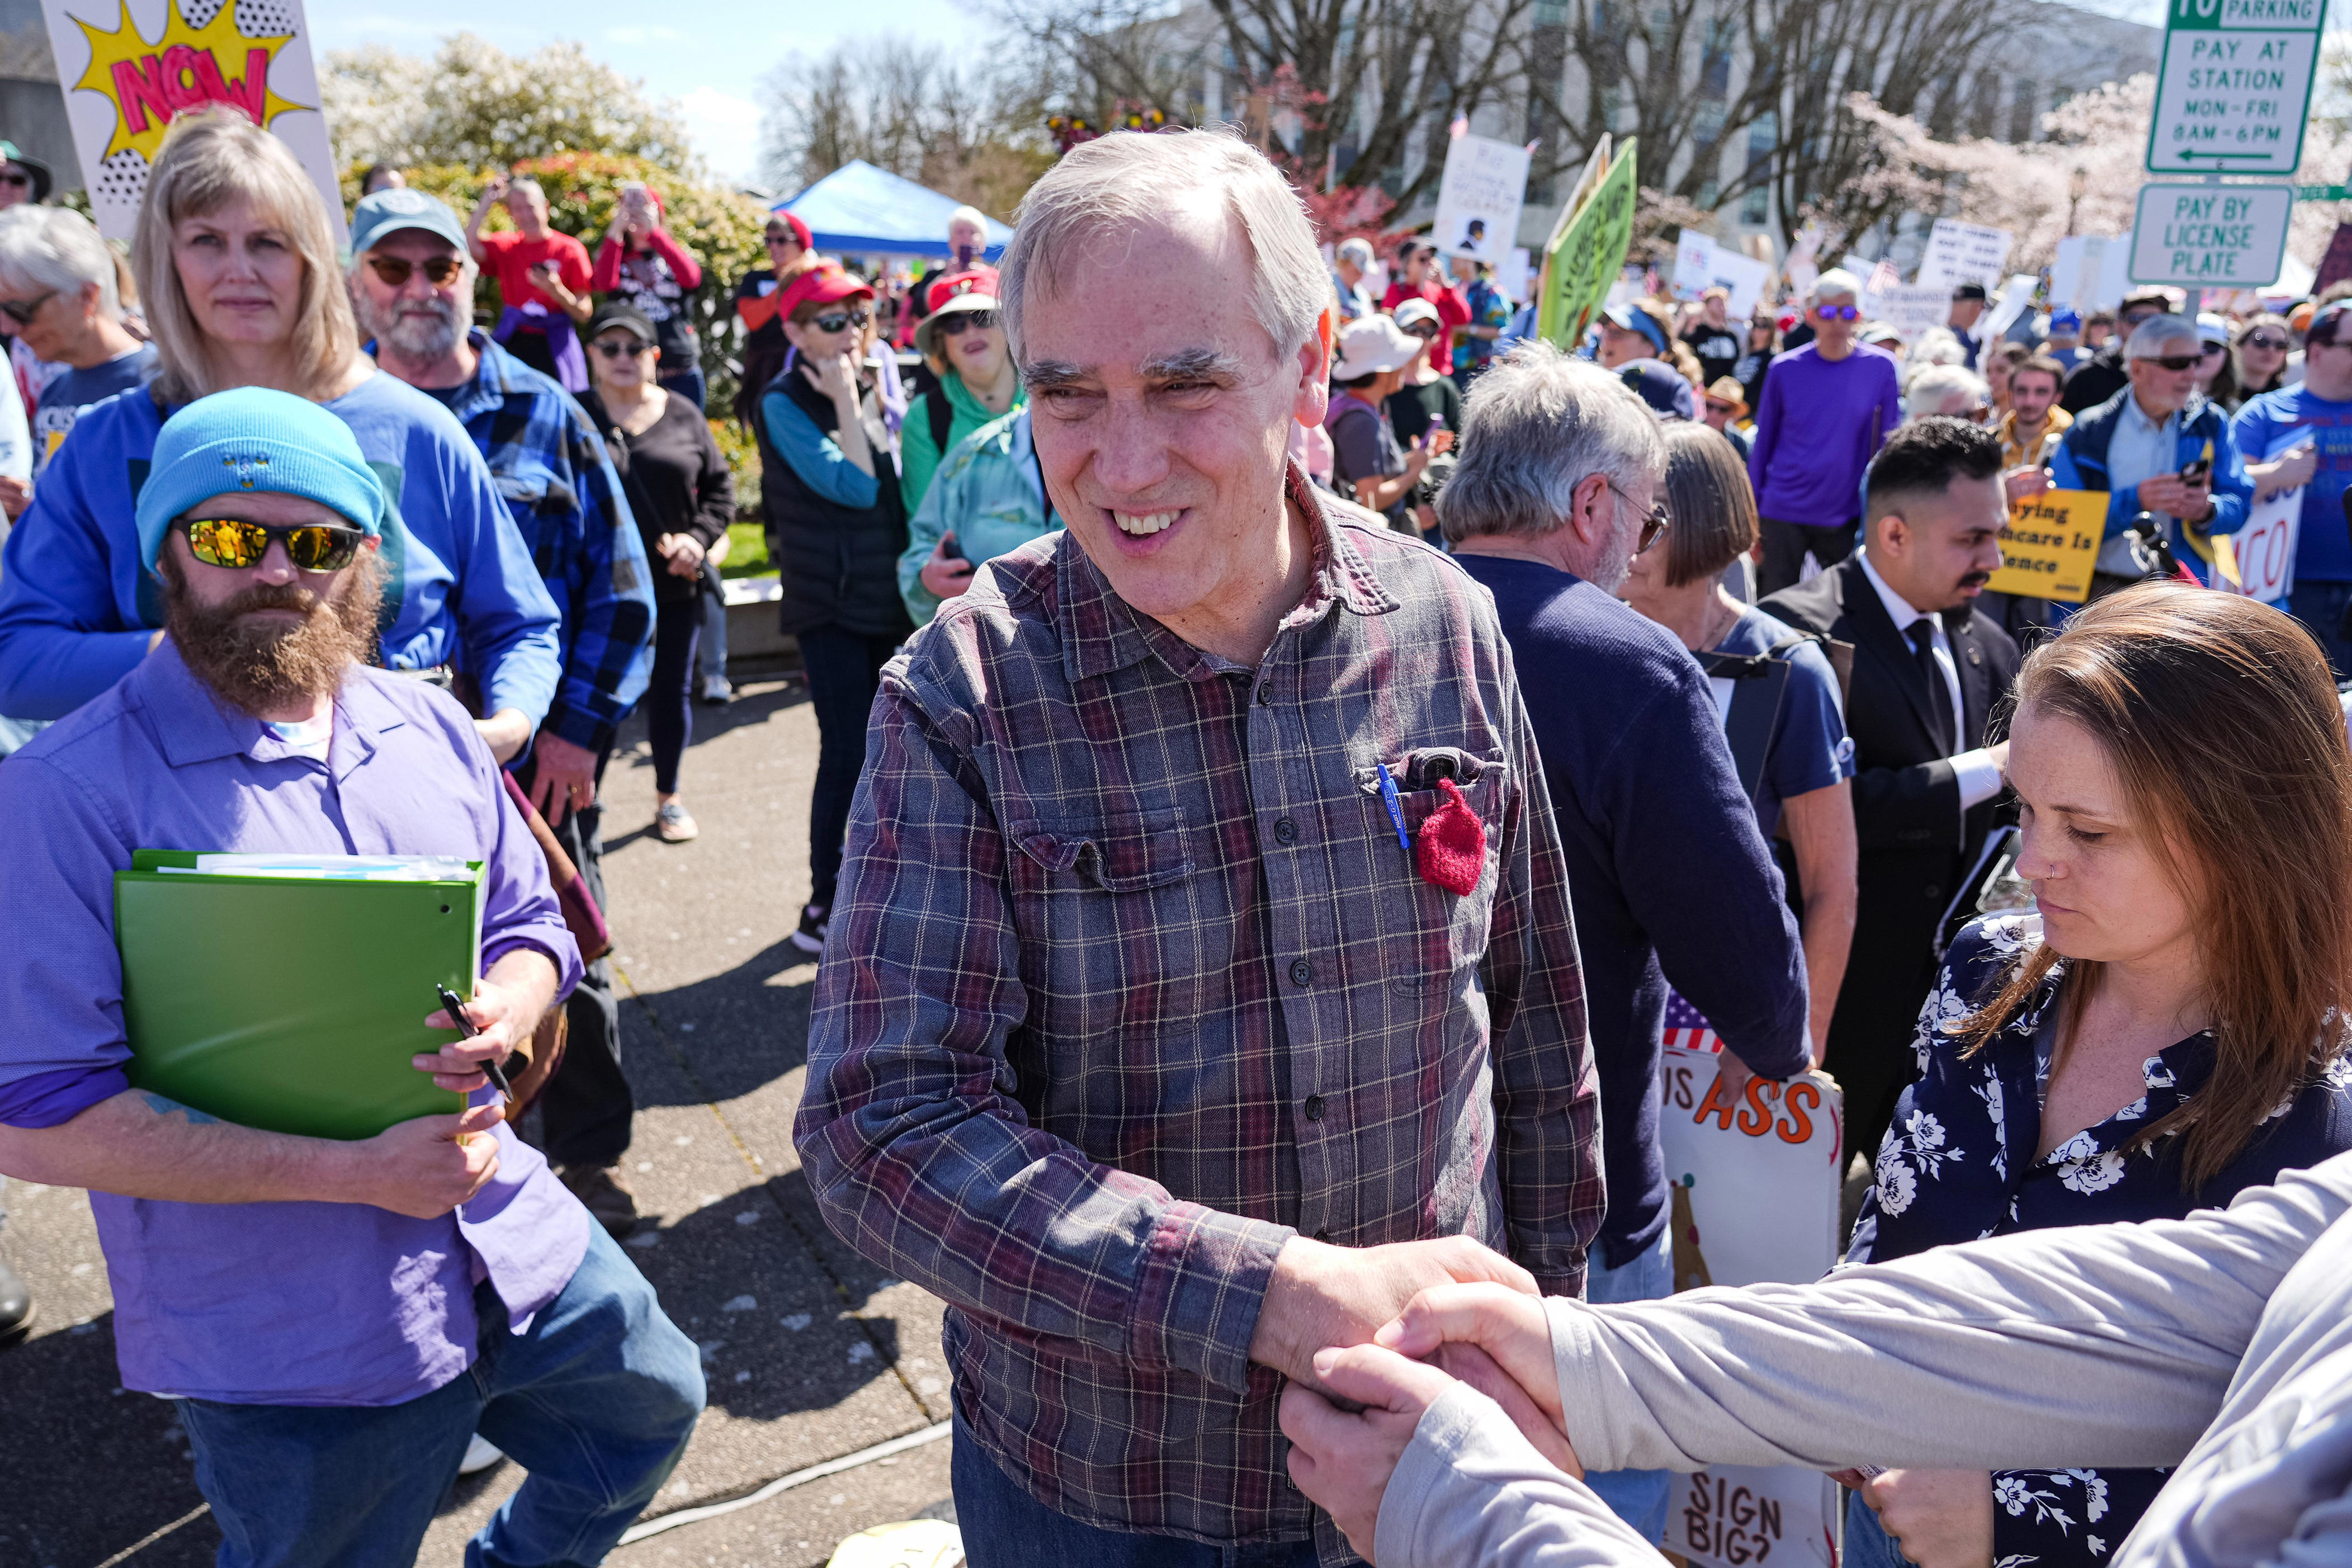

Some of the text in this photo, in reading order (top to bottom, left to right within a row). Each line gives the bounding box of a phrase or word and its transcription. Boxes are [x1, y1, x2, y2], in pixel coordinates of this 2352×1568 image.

[2226, 0, 2313, 20] PARKING
[2192, 39, 2289, 61] PAY AT
[111, 44, 269, 135] NOW
[2187, 68, 2285, 90] STATION
[2174, 195, 2253, 221] PAY BY
[2164, 224, 2255, 249] LICENSE
[2170, 251, 2238, 277] PLATE
[2072, 532, 2092, 549] Is
[2002, 551, 2058, 573] ence
[1393, 814, 1401, 829] PILOT
[1693, 1069, 1820, 1144] ASS
[1689, 1471, 1782, 1540] SIGN
[1683, 1506, 1770, 1566] BIG?
